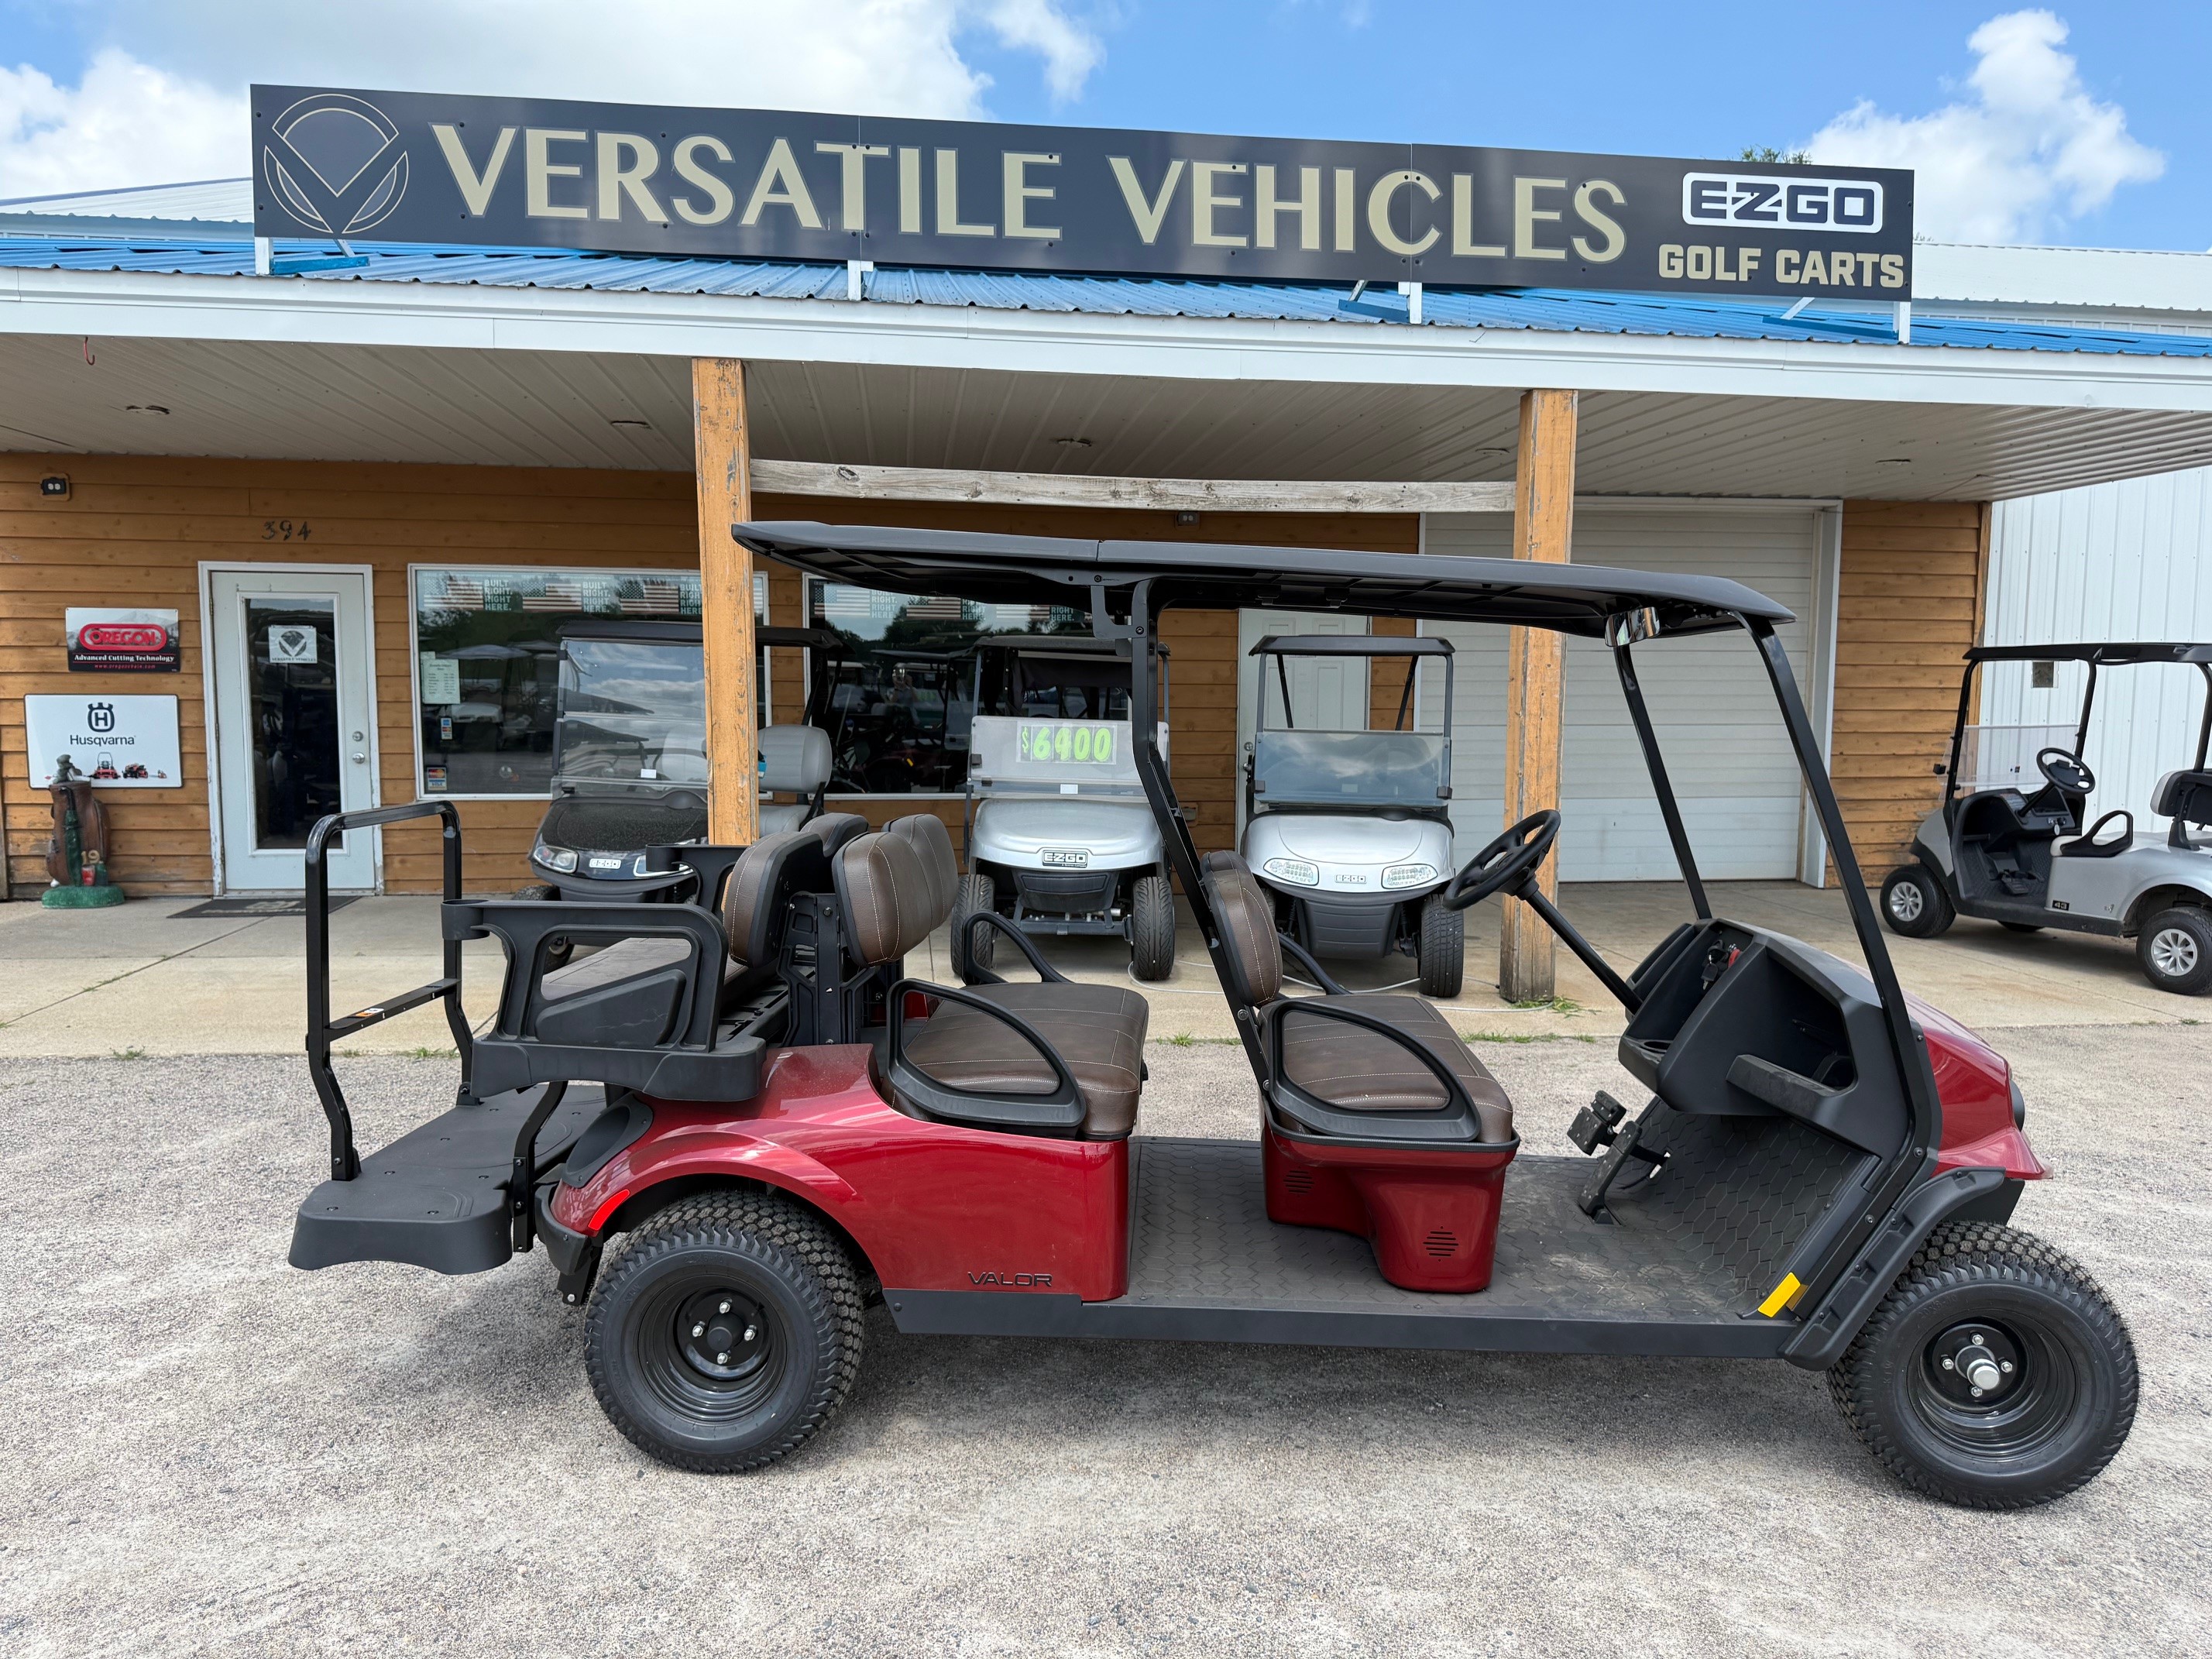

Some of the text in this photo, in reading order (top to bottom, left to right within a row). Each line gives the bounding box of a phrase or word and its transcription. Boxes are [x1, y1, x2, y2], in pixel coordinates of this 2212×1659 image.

[431, 124, 1626, 264] VERSATILE VEHICLES
[1690, 179, 1875, 226] EZGO
[1659, 243, 1905, 289] GOLF CARTS
[261, 520, 311, 541] 394
[90, 630, 156, 644] OREGON
[70, 734, 136, 747] Husqvarna
[1022, 726, 1112, 762] $6400
[81, 849, 101, 866] 19
[1044, 852, 1086, 864] EZGO
[967, 1271, 1053, 1287] VALOR
